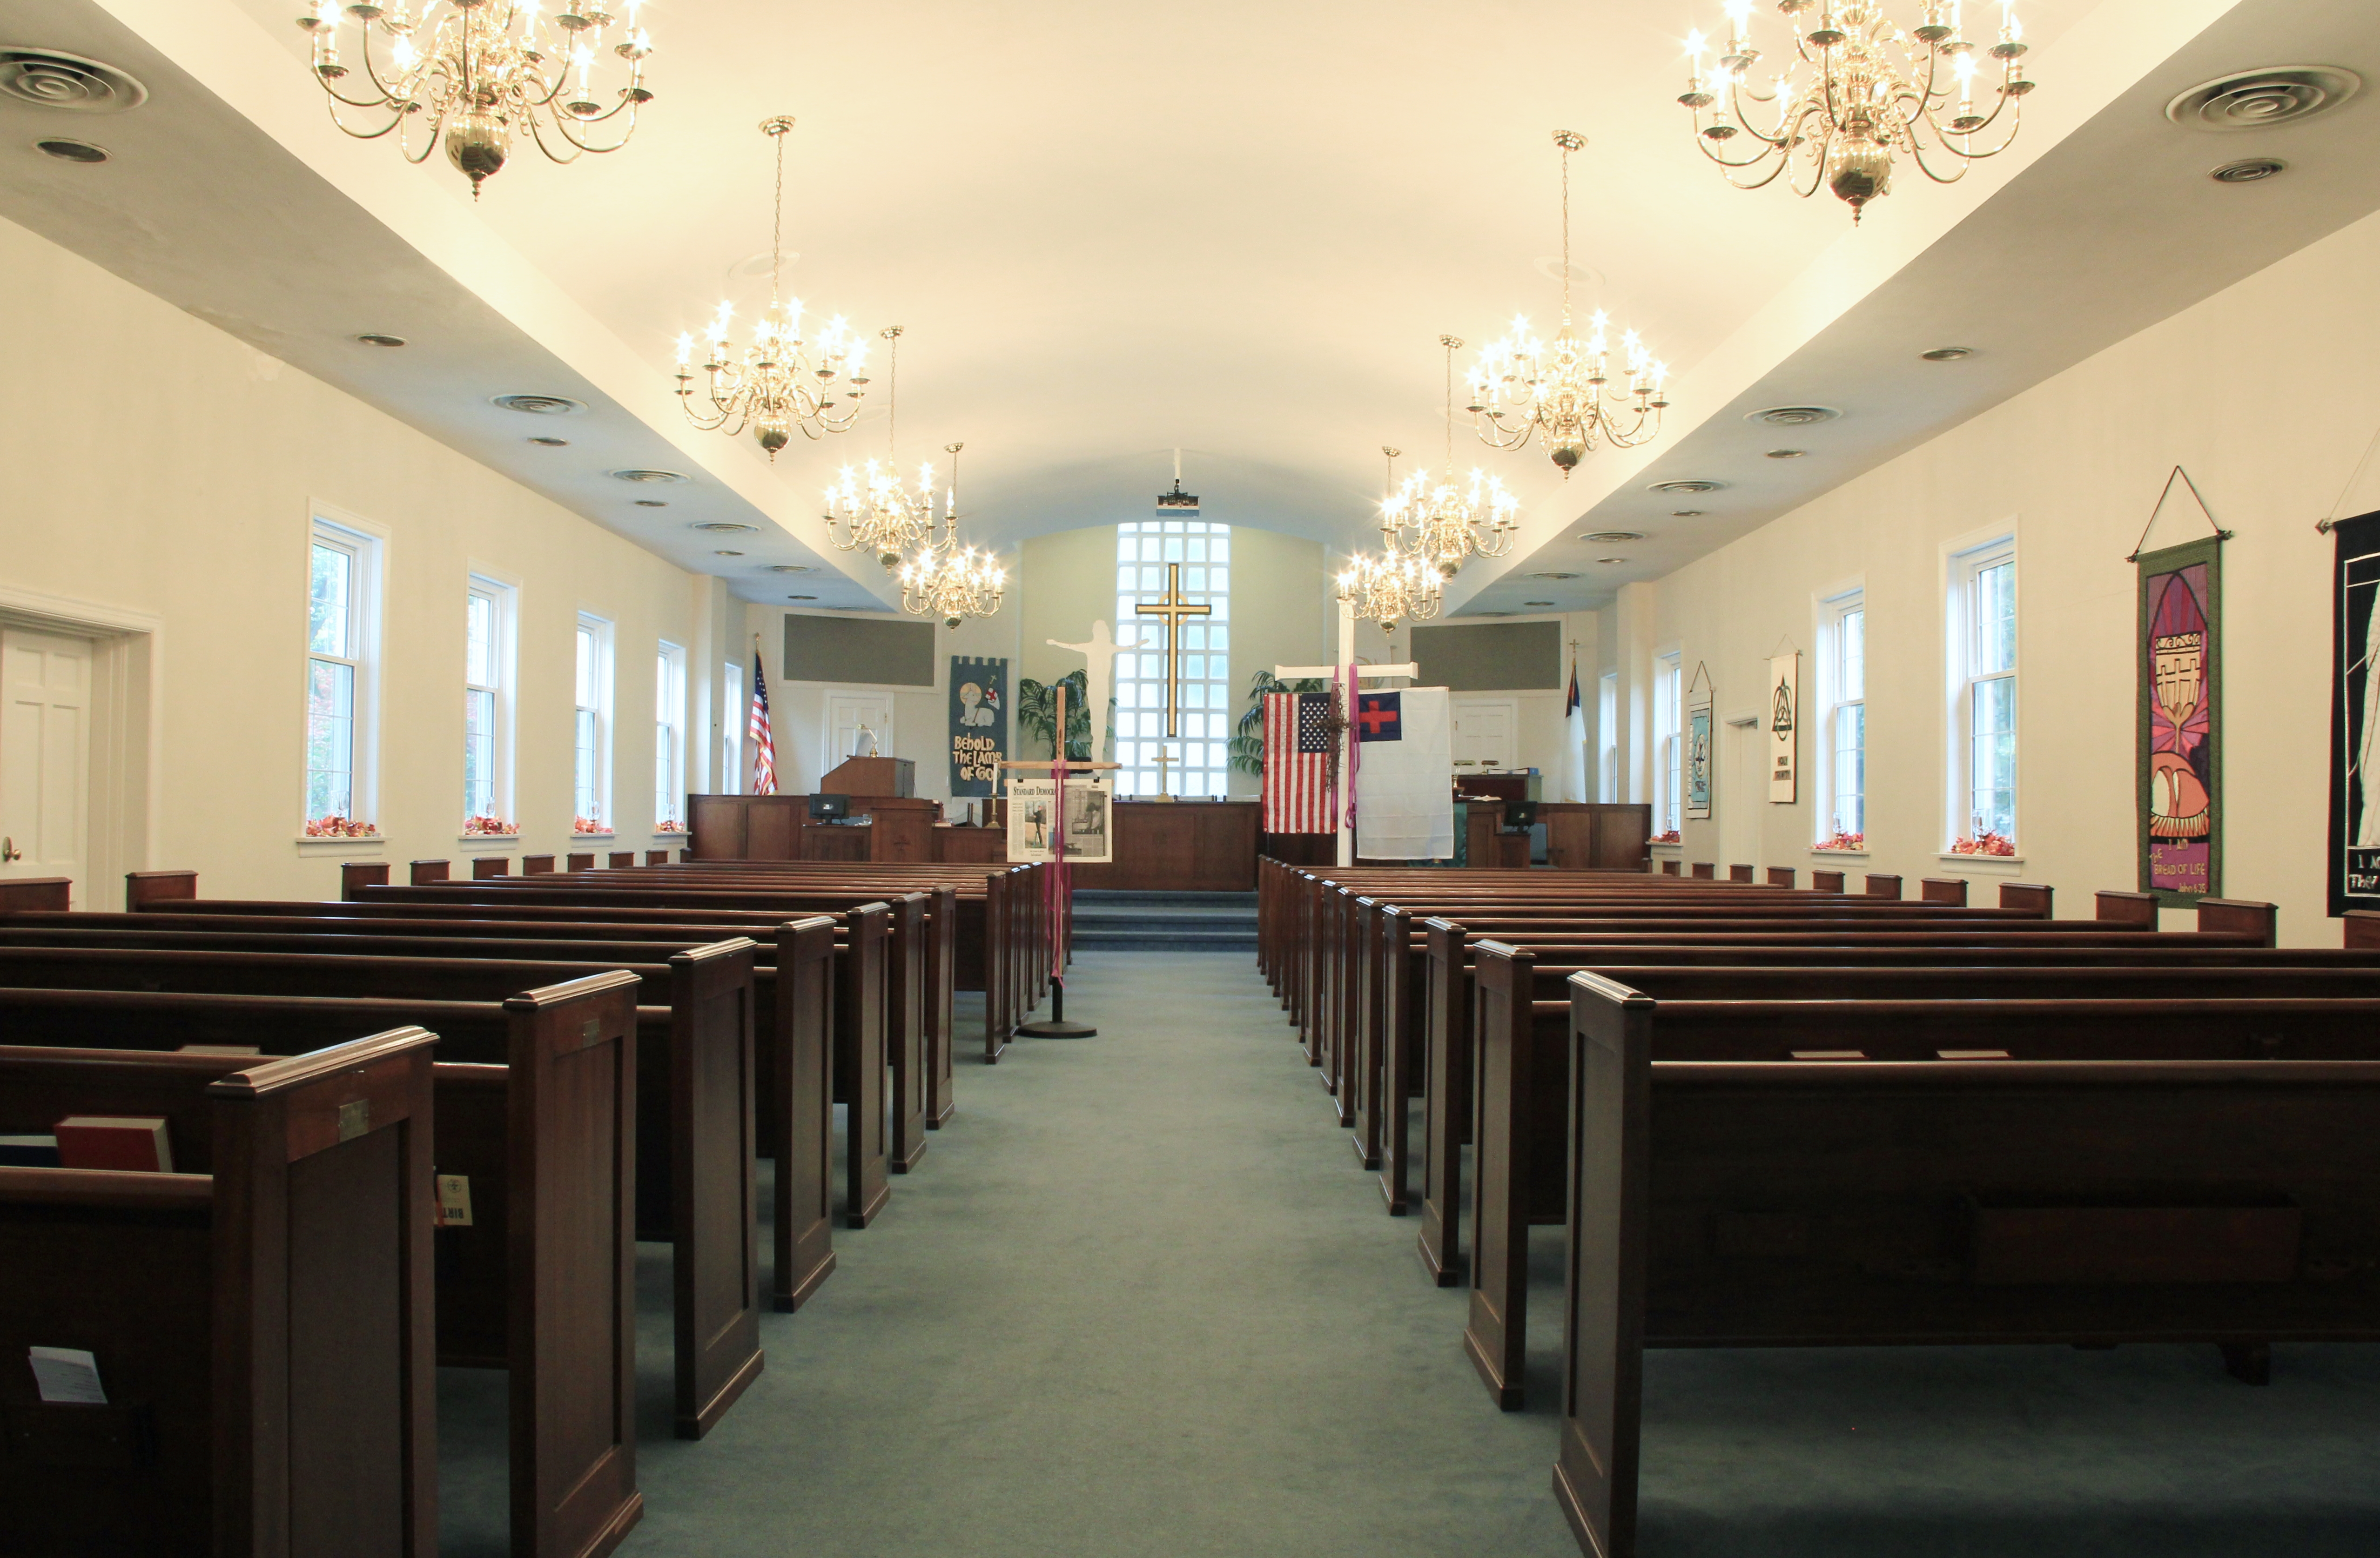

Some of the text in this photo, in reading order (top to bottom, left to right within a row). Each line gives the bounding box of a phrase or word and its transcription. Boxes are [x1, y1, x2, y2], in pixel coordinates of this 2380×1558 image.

[973, 750, 1002, 767] LAMB
[960, 766, 974, 781] OF
[1014, 786, 1035, 795] STANDARD
[2168, 839, 2172, 850] I
[2358, 854, 2364, 868] I
[2154, 863, 2205, 875] BREAD OF LIFE
